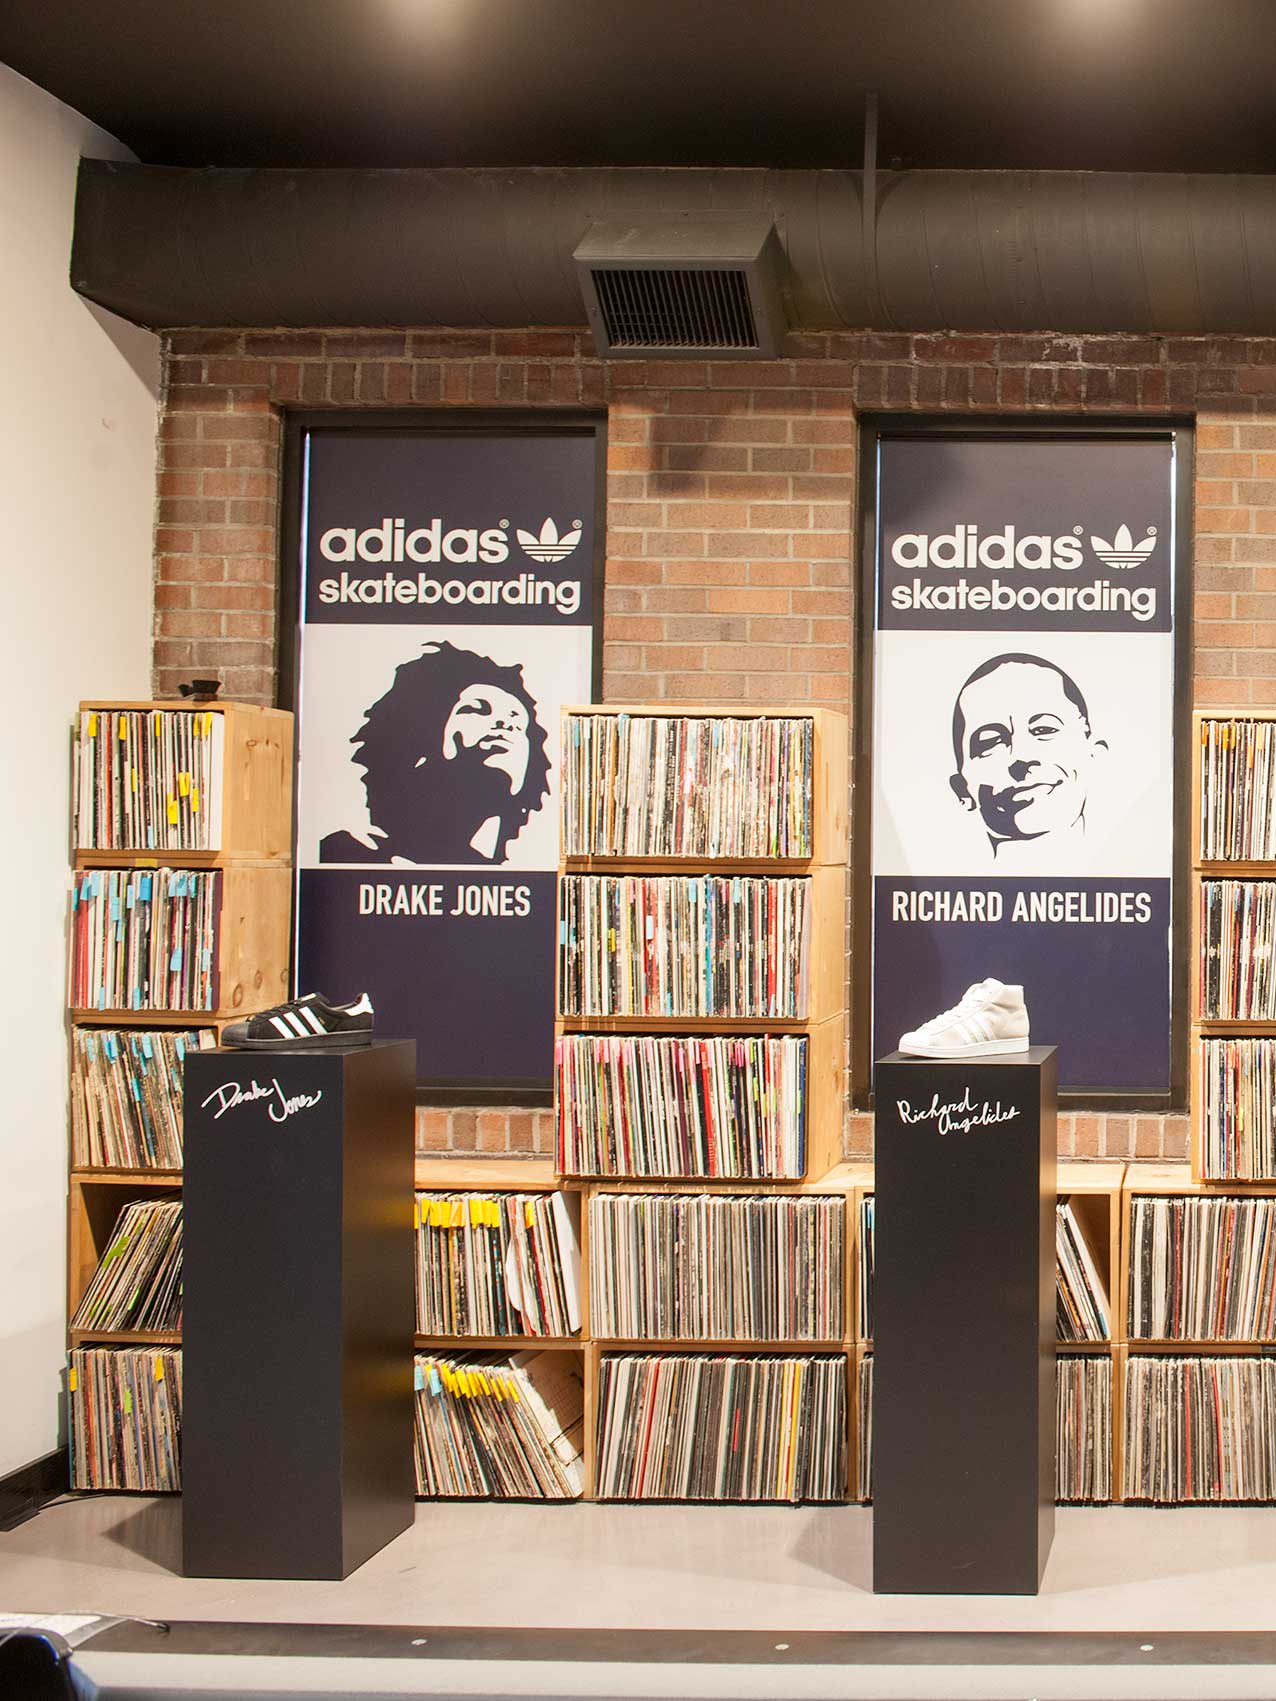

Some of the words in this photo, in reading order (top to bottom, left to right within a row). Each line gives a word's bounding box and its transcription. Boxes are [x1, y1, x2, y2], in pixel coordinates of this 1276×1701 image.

[319, 518, 509, 563] adidas
[891, 524, 1083, 570] adidas
[319, 572, 581, 615] skateboarding
[891, 578, 1156, 622] skateboarding
[359, 884, 443, 915] DRAKE
[450, 885, 531, 916] JONES
[892, 891, 1003, 922] RICHARD
[1011, 891, 1152, 923] ANGELIDES
[896, 1087, 978, 1123] Richard
